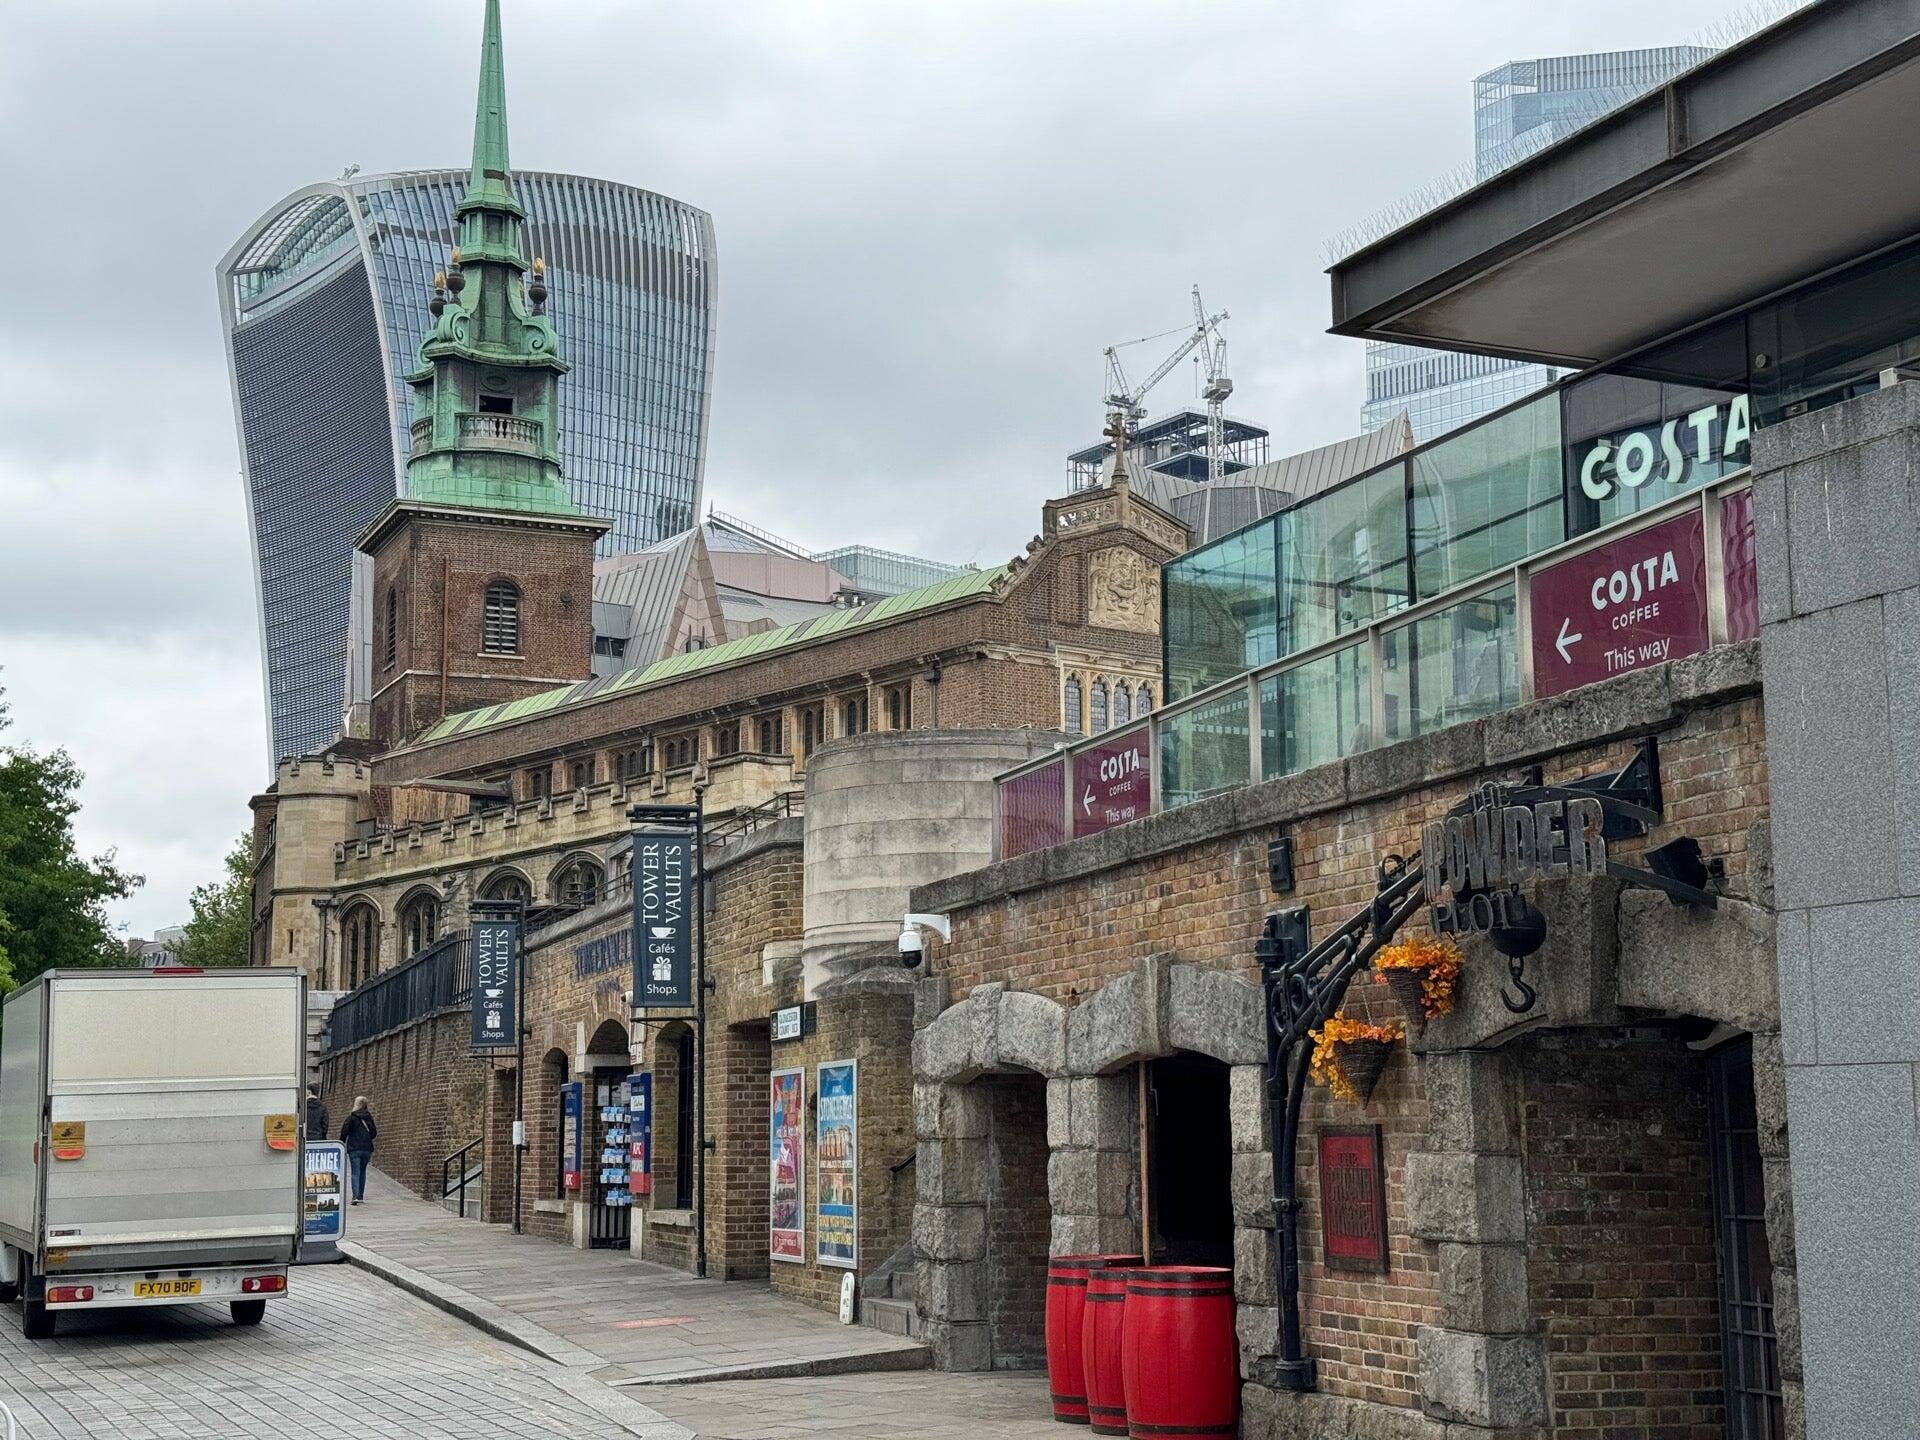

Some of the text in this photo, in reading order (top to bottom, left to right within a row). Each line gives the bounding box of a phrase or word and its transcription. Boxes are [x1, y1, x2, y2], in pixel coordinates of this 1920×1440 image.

[1581, 393, 1750, 500] COSTA
[1592, 551, 1679, 610] COSTA
[1612, 602, 1660, 630] COFFEE
[1604, 637, 1670, 672] This way
[1100, 747, 1140, 782] COSTA
[1109, 781, 1131, 797] COFFEE
[1105, 804, 1136, 825] This way
[1422, 798, 1608, 903] POWDER
[642, 842, 659, 923] TOWER
[665, 845, 682, 923] VAULTS
[479, 928, 492, 987] TOWER
[496, 929, 509, 987] VAULTS
[648, 943, 676, 954] Cafés
[483, 1001, 504, 1009] Cafés
[646, 984, 678, 996] Shops
[481, 1030, 505, 1039] Shops
